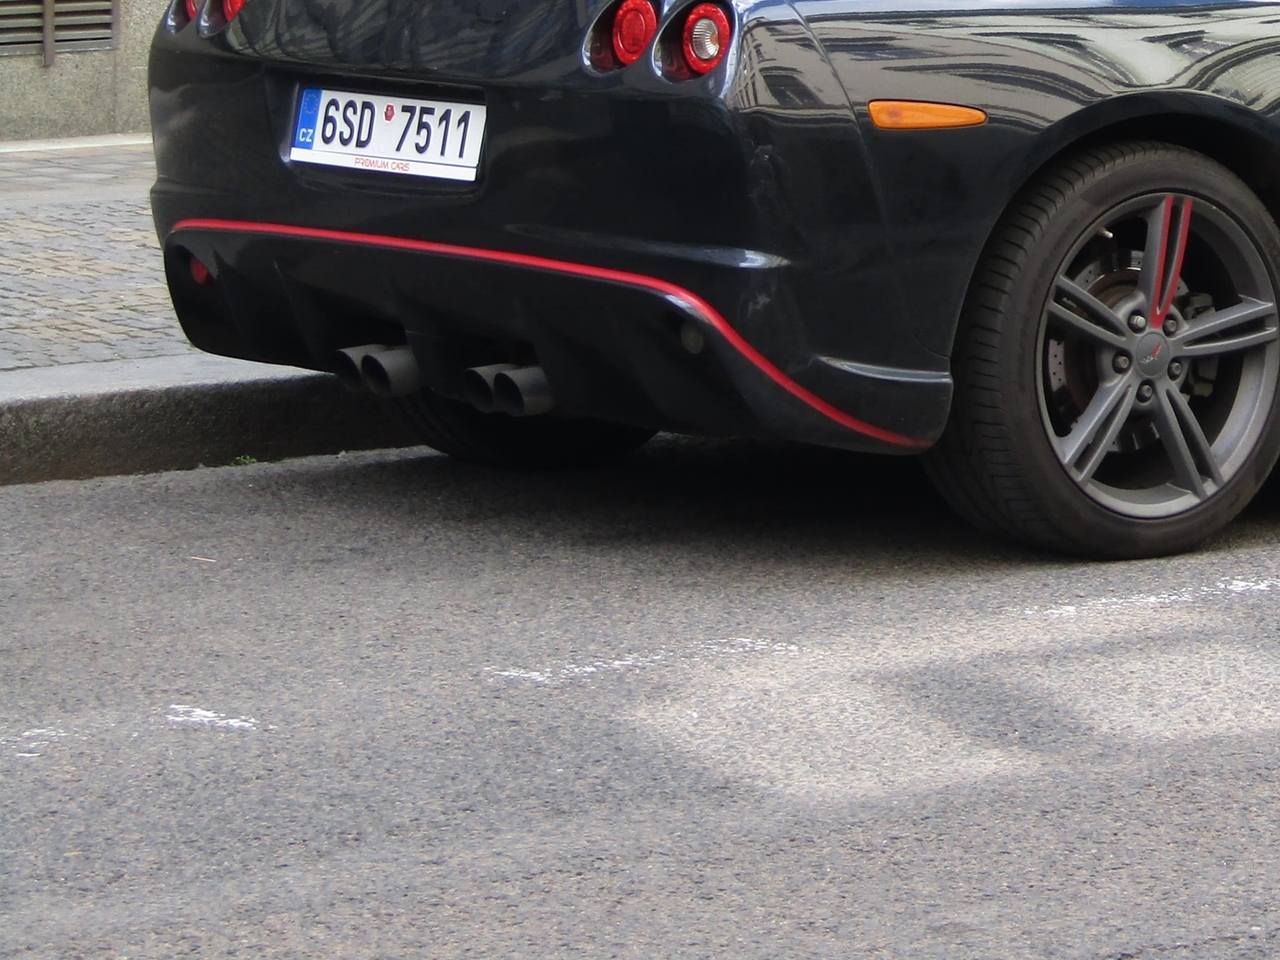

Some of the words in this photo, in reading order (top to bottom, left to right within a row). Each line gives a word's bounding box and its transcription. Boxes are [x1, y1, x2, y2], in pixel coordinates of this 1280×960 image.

[299, 128, 315, 143] CZ
[321, 98, 376, 148] 6SD
[395, 105, 471, 159] 7511
[354, 157, 389, 170] PREMIUM
[390, 161, 410, 172] CARS
